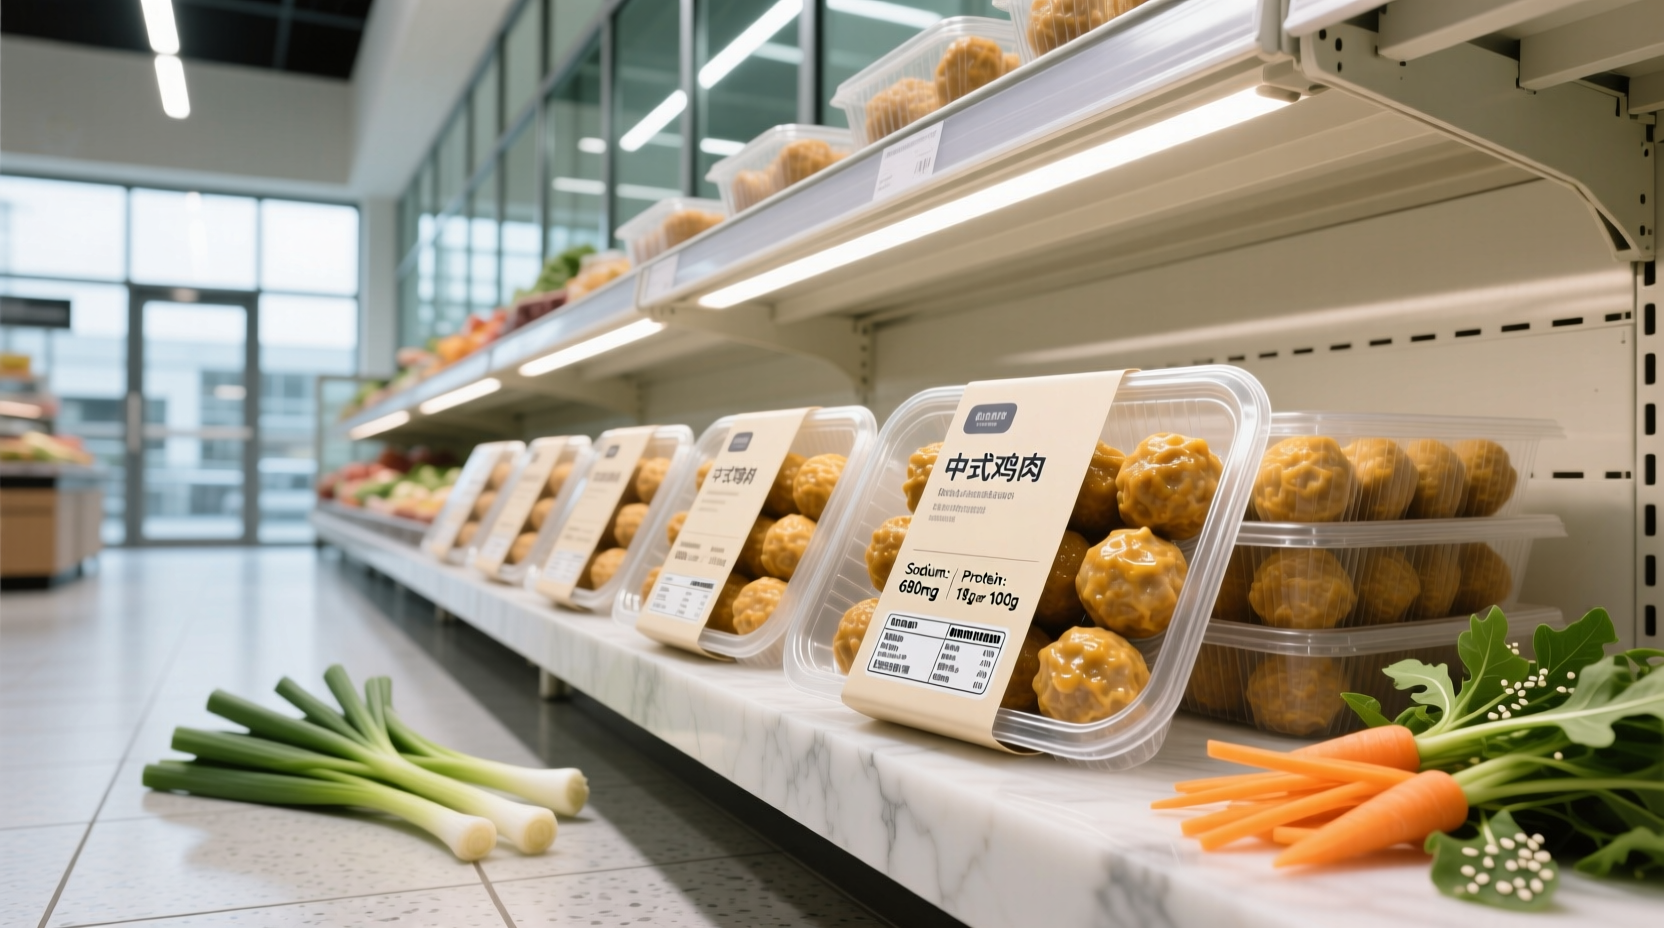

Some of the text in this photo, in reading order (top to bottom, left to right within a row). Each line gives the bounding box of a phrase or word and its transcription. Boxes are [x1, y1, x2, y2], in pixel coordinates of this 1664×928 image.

[945, 452, 1046, 482] 中式鸡肉
[989, 591, 1019, 611] 100g
